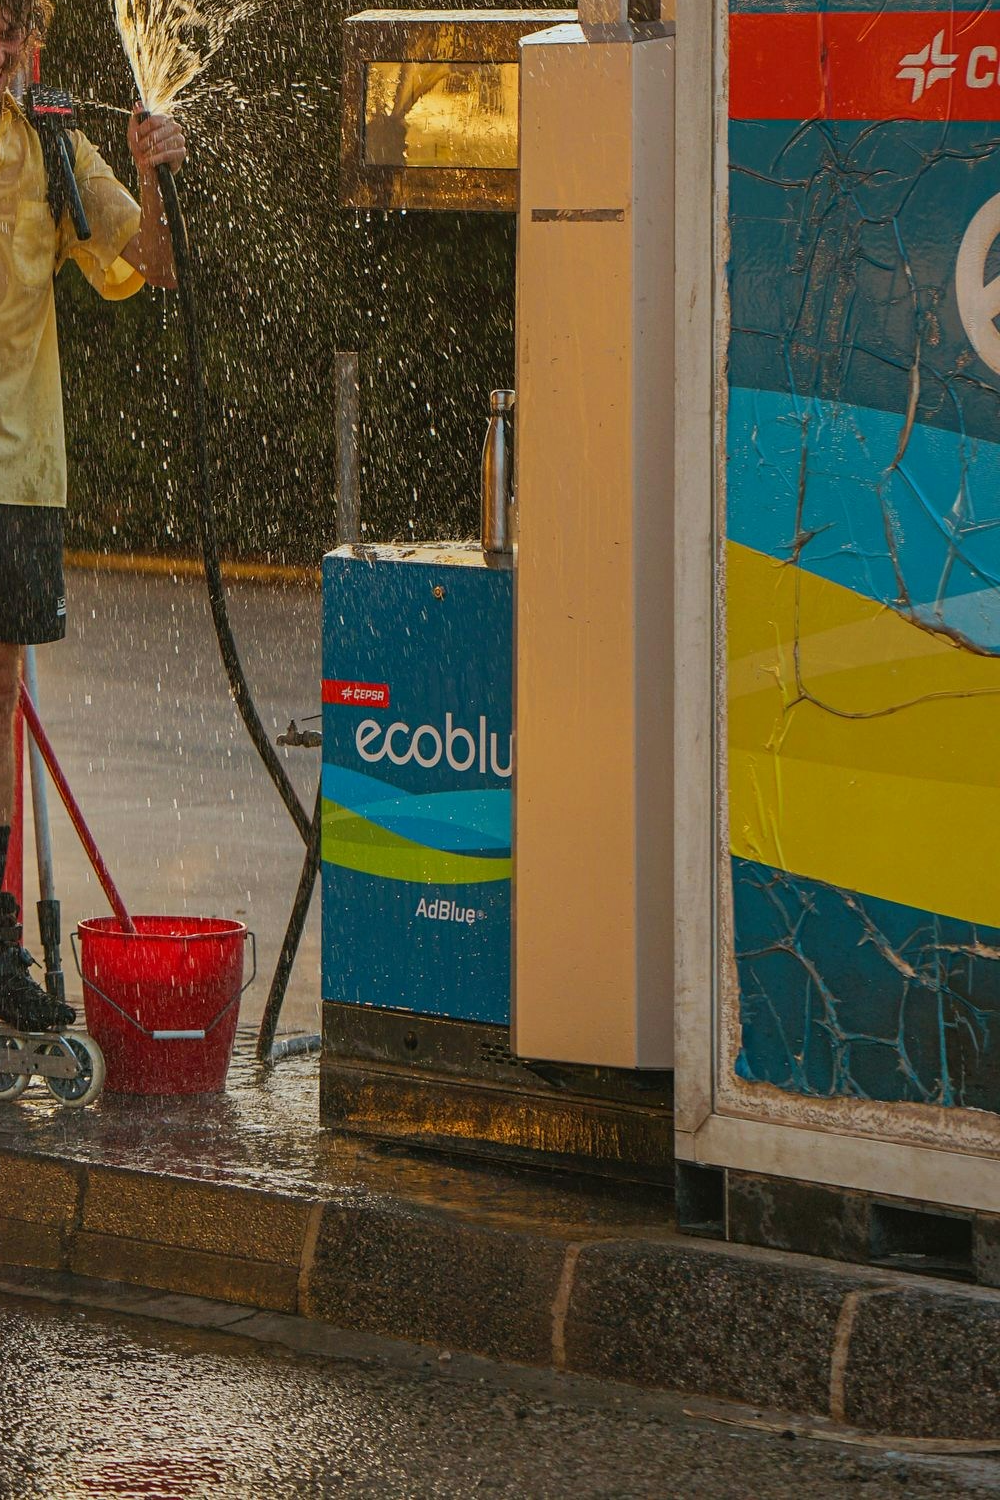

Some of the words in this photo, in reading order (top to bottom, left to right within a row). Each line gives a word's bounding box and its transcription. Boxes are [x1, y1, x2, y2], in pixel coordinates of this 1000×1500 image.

[966, 45, 1000, 89] C
[353, 688, 385, 701] CEPSA
[355, 712, 513, 778] ecoblu
